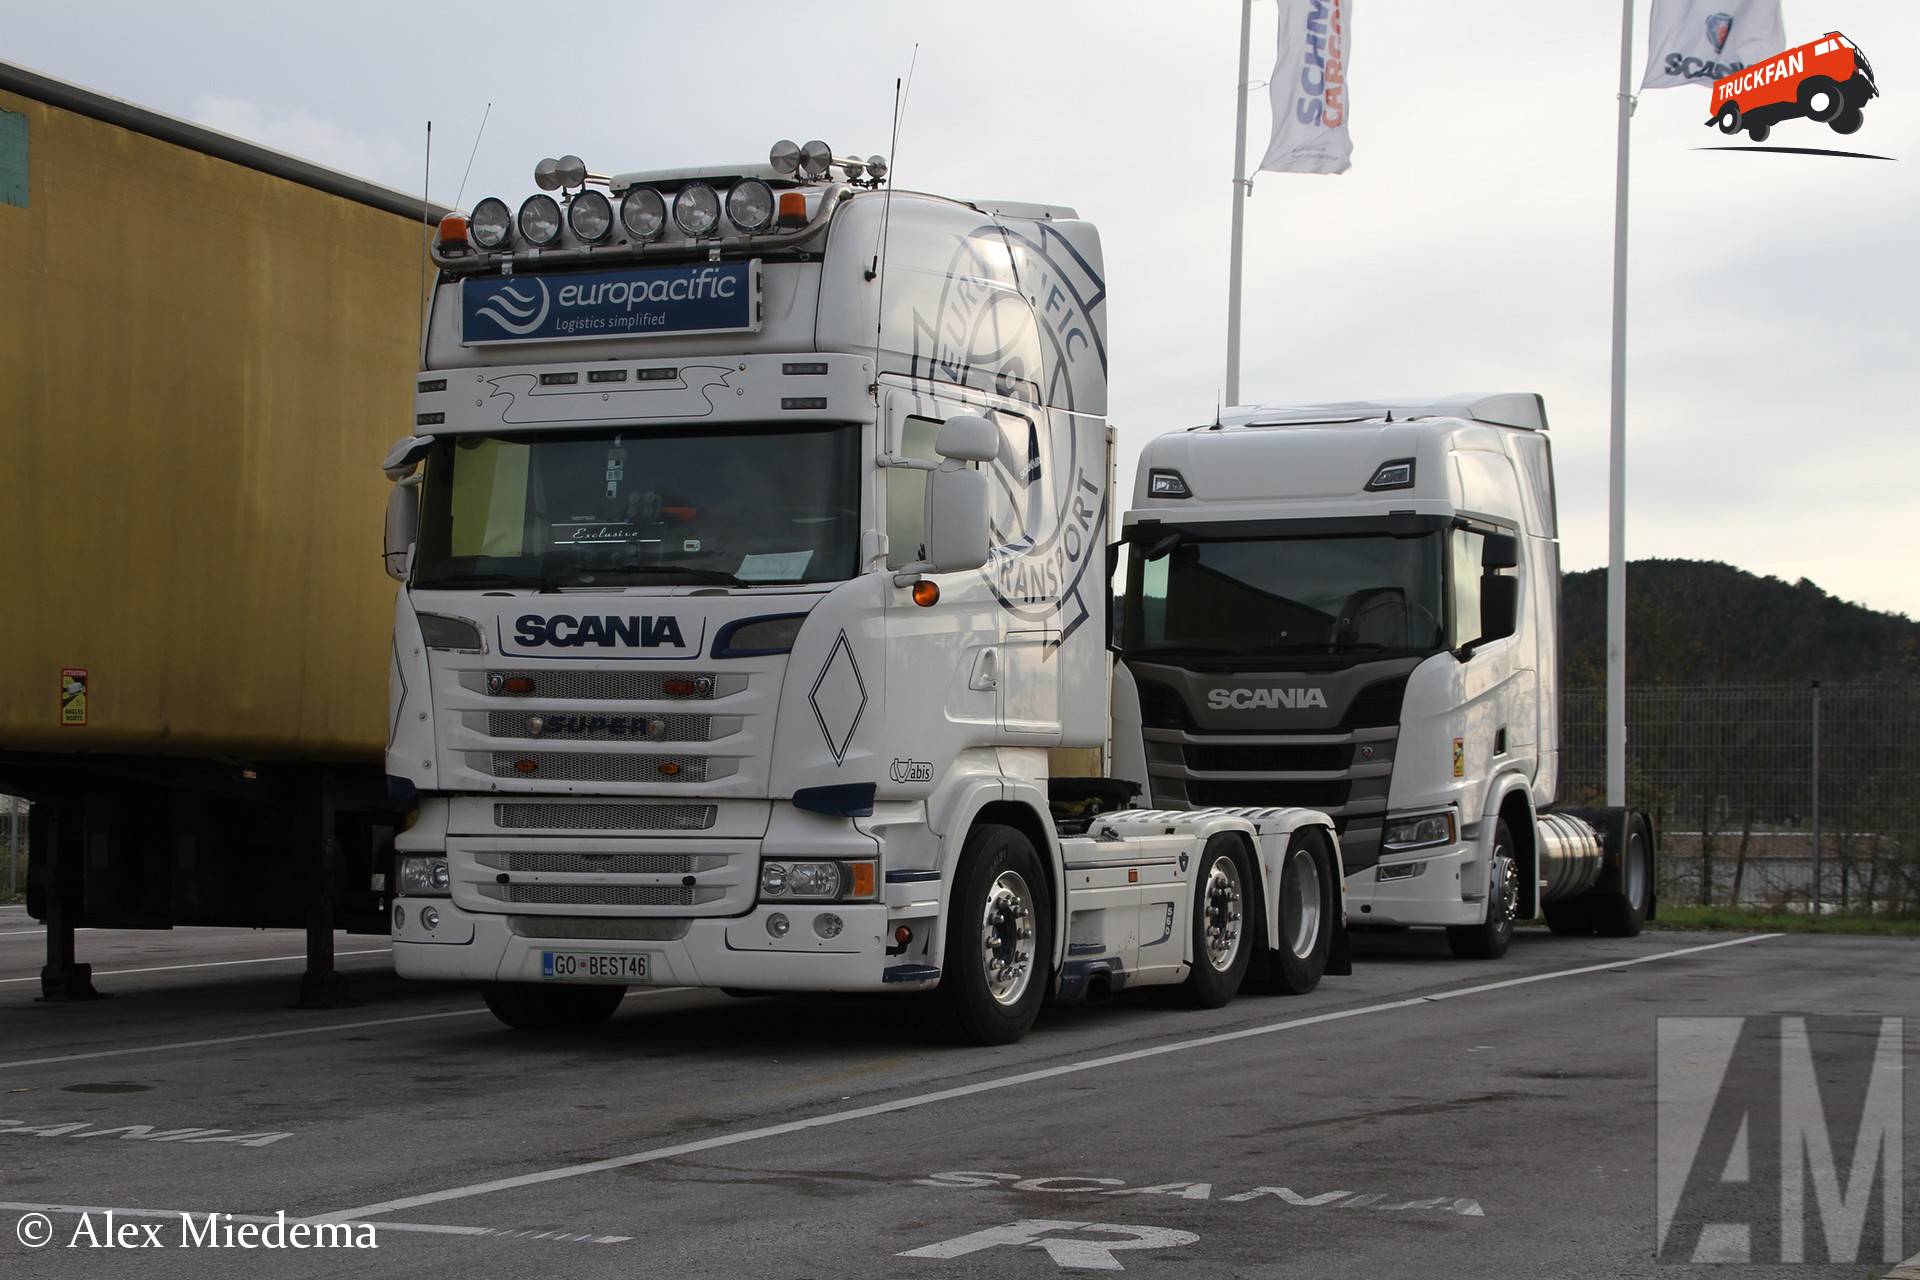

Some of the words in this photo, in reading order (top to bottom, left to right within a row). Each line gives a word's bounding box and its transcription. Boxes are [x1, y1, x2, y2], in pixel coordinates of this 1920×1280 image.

[559, 268, 736, 311] europacific
[556, 317, 605, 333] Logistics
[609, 312, 665, 328] simplified
[514, 615, 686, 647] SCANIA
[1208, 688, 1328, 709] SCANIA
[549, 715, 648, 736] SUPER
[555, 955, 577, 975] GO
[589, 956, 646, 976] BEST46
[895, 1218, 1200, 1271] R
